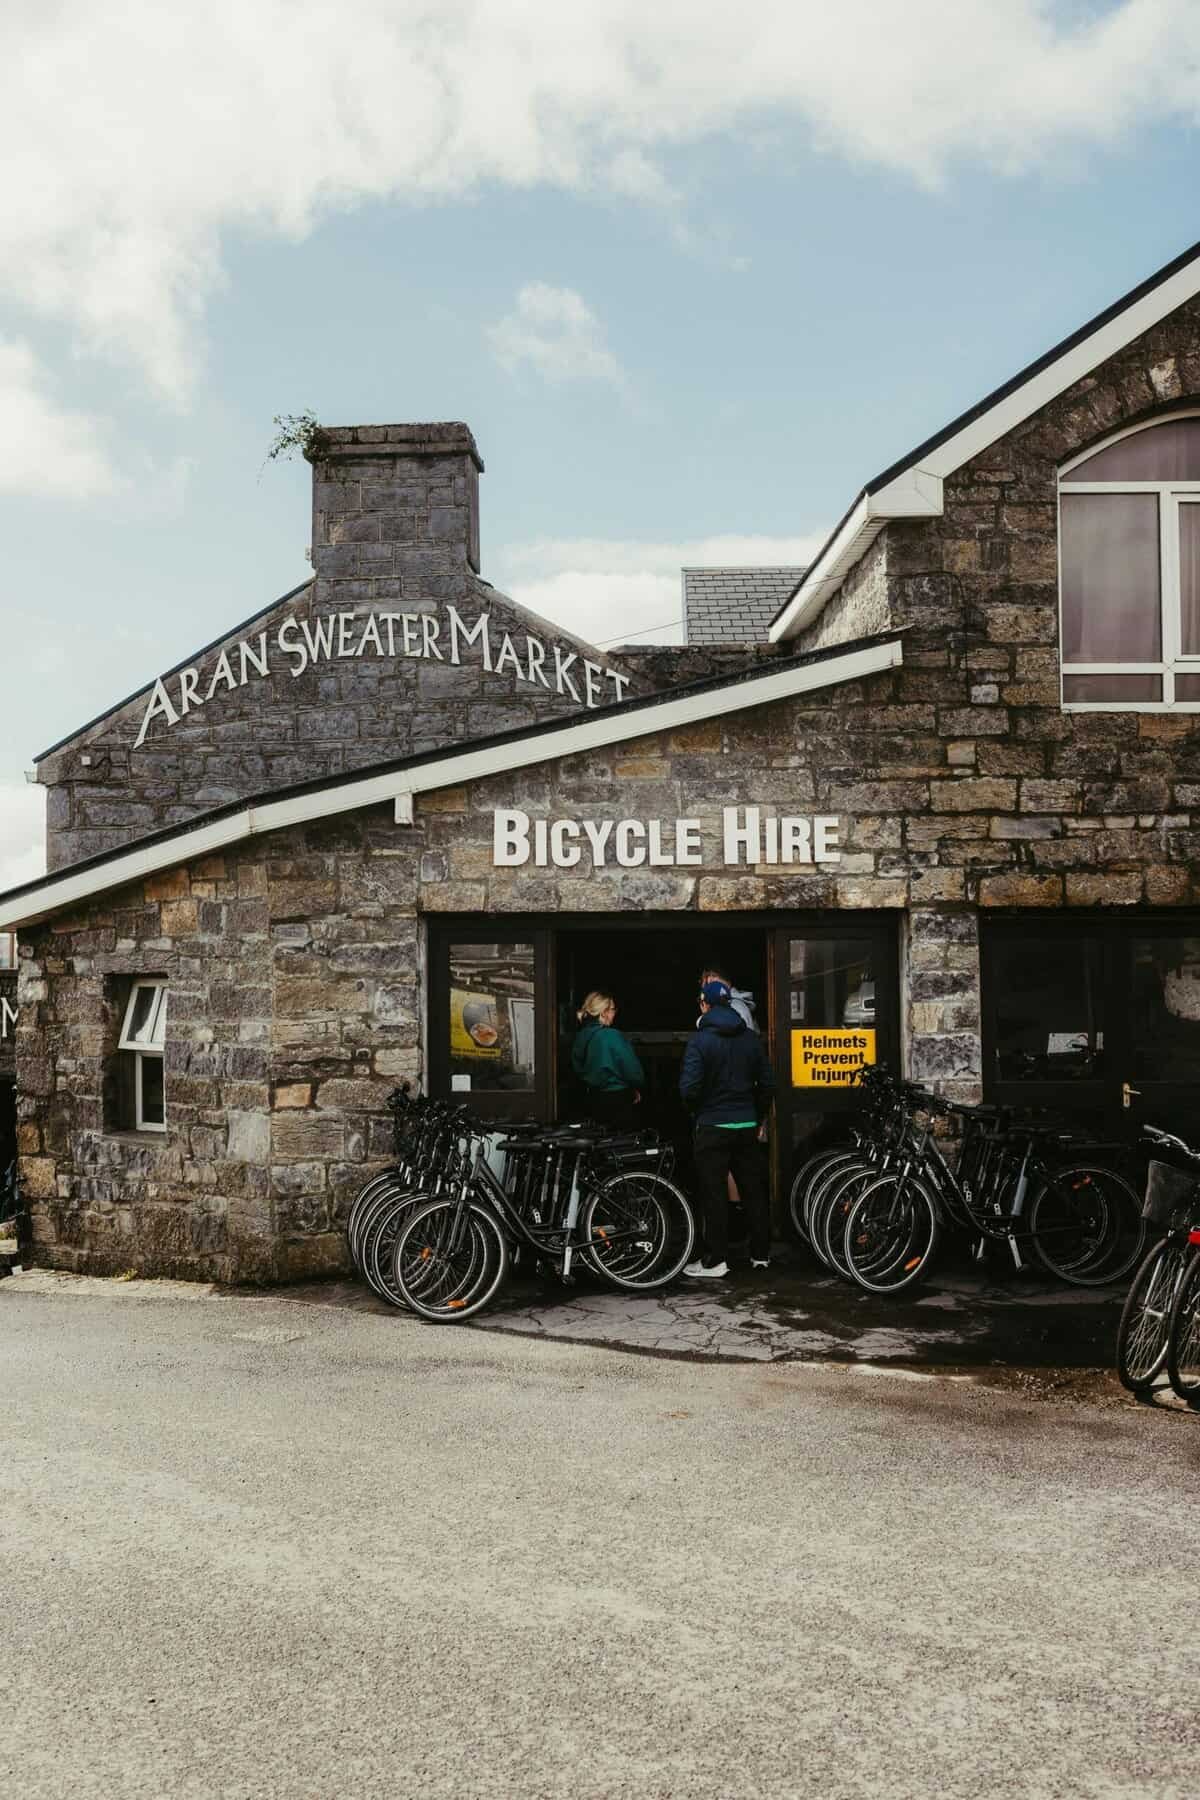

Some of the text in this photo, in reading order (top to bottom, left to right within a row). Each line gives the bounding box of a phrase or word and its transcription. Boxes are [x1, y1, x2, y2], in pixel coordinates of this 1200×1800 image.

[133, 605, 630, 749] ARAN SWEATER MARKET
[493, 807, 841, 867] BICYCLE HIRE
[802, 1035, 867, 1049] Helmets
[804, 1051, 865, 1065] Prevent
[812, 1068, 858, 1084] Injury
